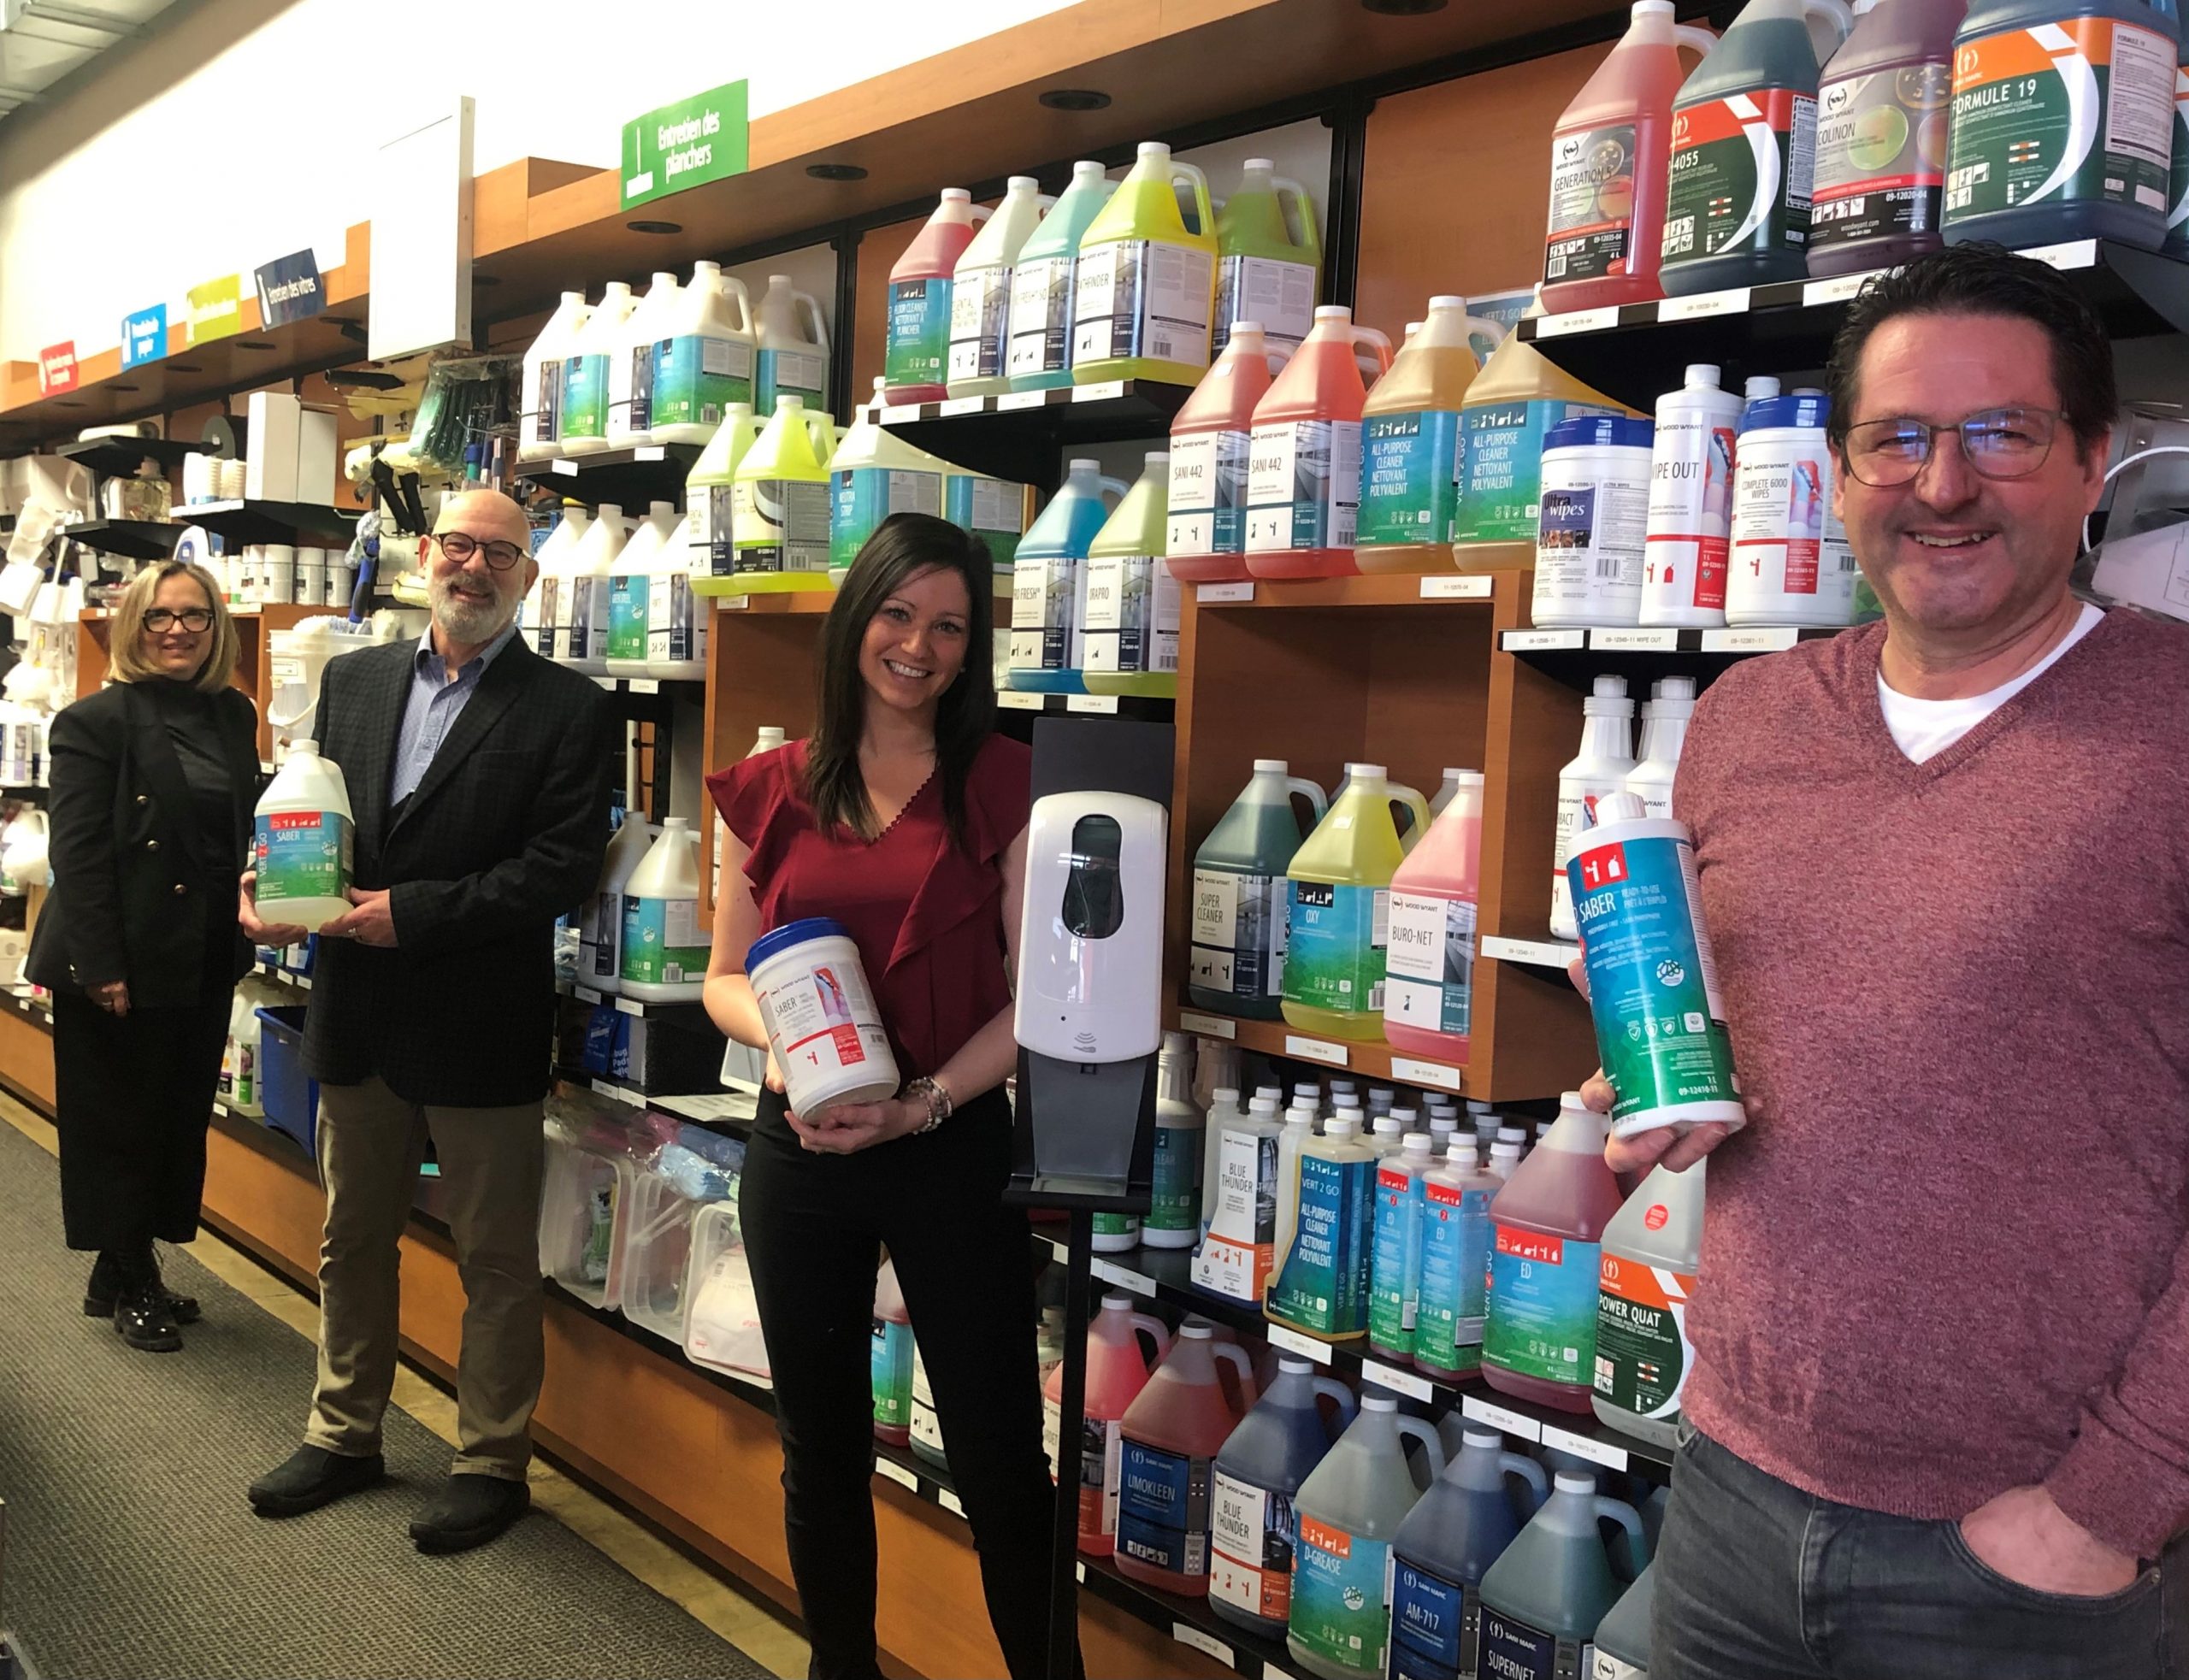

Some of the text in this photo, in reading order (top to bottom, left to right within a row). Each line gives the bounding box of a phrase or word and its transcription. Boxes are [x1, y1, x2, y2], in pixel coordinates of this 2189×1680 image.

[1951, 78, 2037, 115] FORMULE 19
[1835, 108, 1855, 120] WYANT
[658, 108, 720, 151] Entretien des
[1816, 122, 1856, 146] COLINON
[665, 143, 712, 185] planchers
[1569, 157, 1585, 168] WYANT
[1554, 168, 1605, 192] GENERATION
[1885, 191, 1927, 203] 09-12020-04
[906, 302, 928, 314] CLEANER
[1501, 309, 1506, 320] 2
[1508, 308, 1519, 319] GO
[1372, 440, 1413, 455] ALL-PURPOSE
[1472, 431, 1518, 448] ALL-PURPOSE
[1478, 446, 1508, 461] CLEANER
[1251, 457, 1282, 474] SANI 442
[1377, 456, 1404, 469] CLEANER
[1473, 461, 1513, 476] NETTOYANT
[1672, 462, 1700, 480] OUT
[1174, 464, 1203, 480] SANI 442
[1372, 469, 1407, 482] NETTOYANT
[1370, 481, 1408, 497] POLYVALENT
[1471, 475, 1513, 491] POLYVALENT
[1742, 478, 1788, 491] COMPLETE 6000
[1544, 493, 1572, 511] Ultra
[1751, 488, 1770, 499] WIPES
[1549, 501, 1586, 523] wipes
[259, 832, 268, 846] GO
[276, 830, 301, 842] SABER
[1201, 892, 1220, 908] SUPER
[1405, 902, 1438, 913] WOOD WYANT
[1578, 892, 1617, 924] SABER
[1196, 907, 1224, 924] CLEANER
[1305, 908, 1320, 924] OXY
[1392, 926, 1433, 947] BURO-NET
[775, 998, 798, 1017] SABER
[1229, 1162, 1247, 1179] BLUE
[1221, 1172, 1254, 1194] THUNDER
[1301, 1177, 1340, 1197] VERT 2 GO
[1301, 1201, 1336, 1224] ALL-PURPOSE
[1386, 1211, 1395, 1225] ED
[1441, 1211, 1447, 1219] 2
[1305, 1217, 1329, 1236] CLEANER
[1437, 1226, 1445, 1241] ED
[1301, 1233, 1332, 1252] NETTOYANT
[1298, 1248, 1332, 1268] POLYVALENT
[1486, 1250, 1493, 1270] GO
[1520, 1262, 1532, 1279] ED
[1599, 1294, 1662, 1329] POWER QUAT
[1127, 1472, 1177, 1502] LIMOKLEEN
[1240, 1489, 1257, 1500] WYANT
[1223, 1500, 1242, 1521] BLUE
[1216, 1513, 1250, 1540] THUNDER
[1304, 1546, 1342, 1577] D-GREASE
[1417, 1581, 1447, 1600] SANI MARC
[1405, 1601, 1440, 1631] AM-717
[1504, 1631, 1537, 1652] SANI MARC
[1487, 1649, 1536, 1680] SUPERNET
